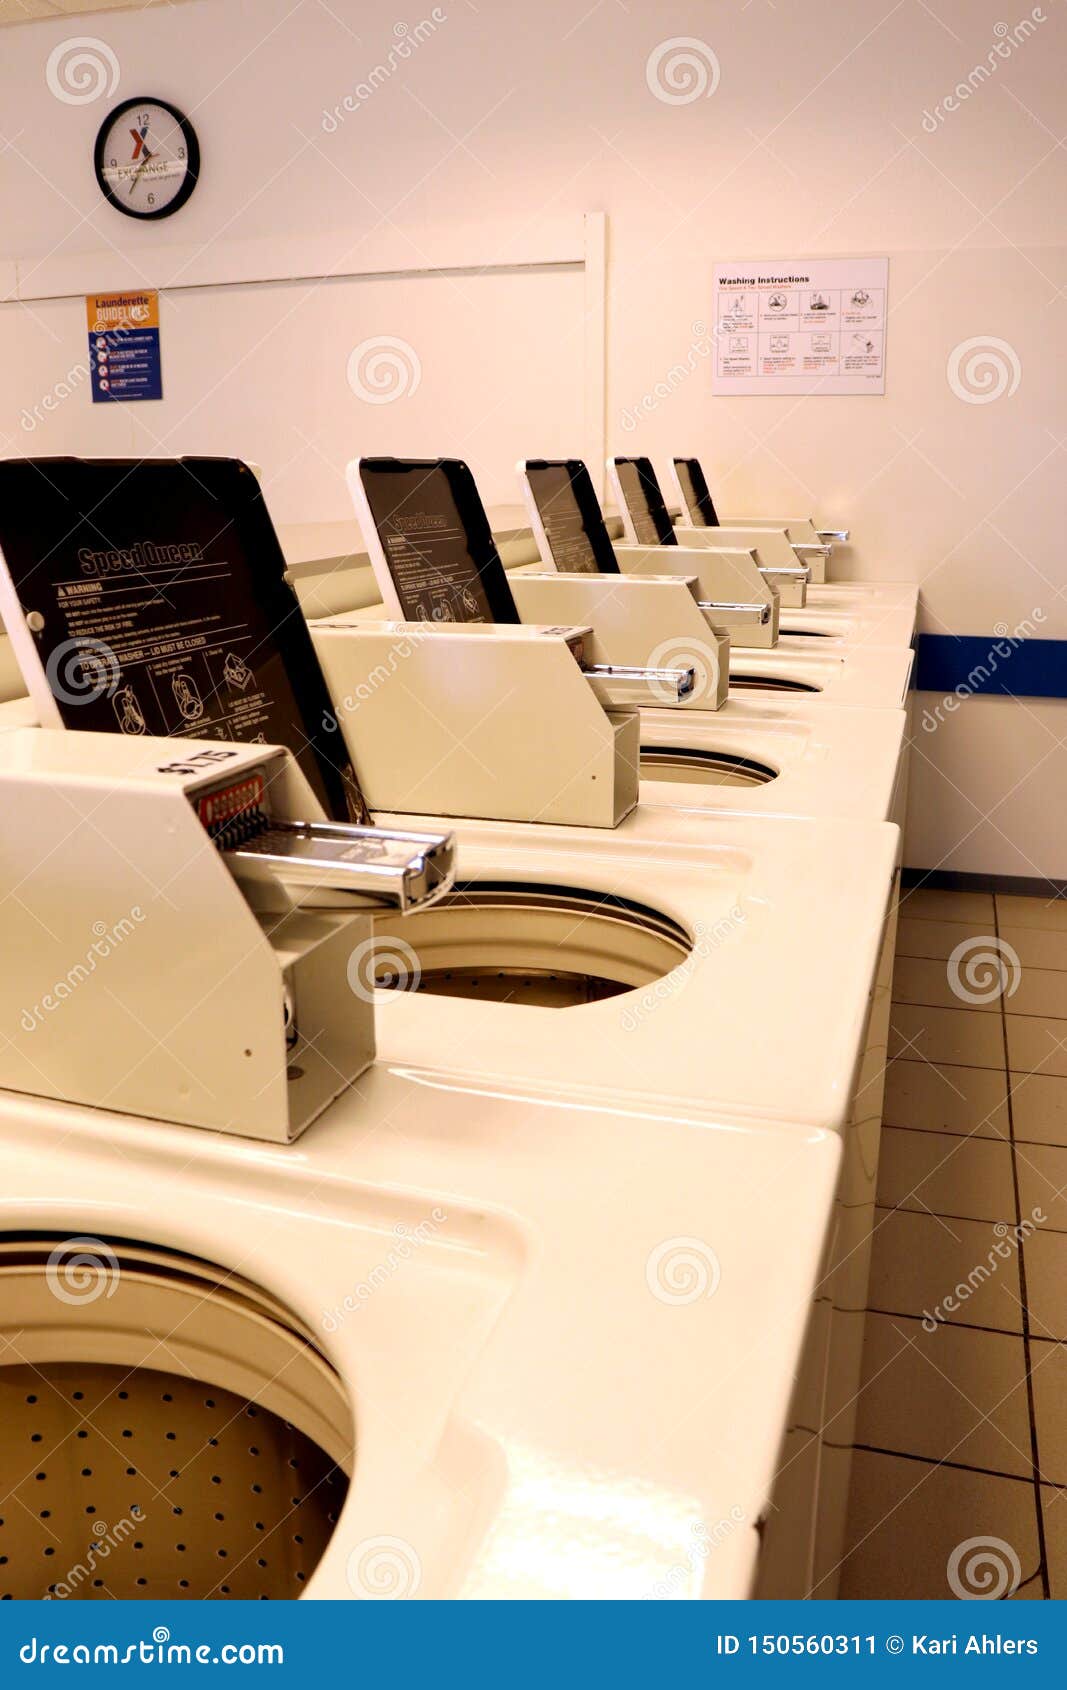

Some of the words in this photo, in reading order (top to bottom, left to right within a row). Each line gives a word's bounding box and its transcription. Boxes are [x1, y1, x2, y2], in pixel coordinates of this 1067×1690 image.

[137, 114, 150, 126] 12
[178, 147, 184, 159] 3
[110, 158, 118, 168] 9
[118, 161, 168, 180] EXANGE
[148, 192, 155, 204] 6
[719, 277, 756, 285] Washing
[96, 296, 149, 308] Launderette
[78, 542, 146, 578] Speed
[144, 541, 204, 566] Queen
[66, 582, 103, 596] WARNING
[150, 646, 160, 656] LID
[160, 643, 176, 654] MUST
[176, 641, 185, 650] BE
